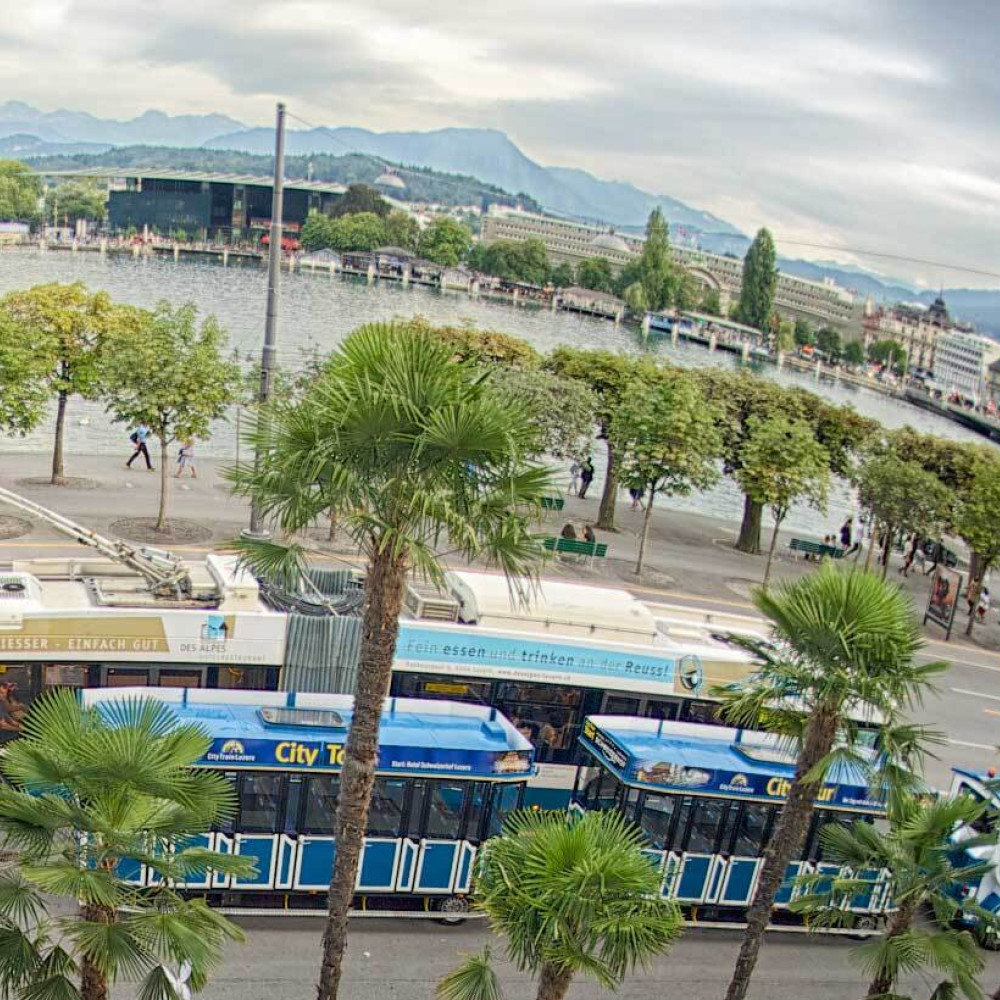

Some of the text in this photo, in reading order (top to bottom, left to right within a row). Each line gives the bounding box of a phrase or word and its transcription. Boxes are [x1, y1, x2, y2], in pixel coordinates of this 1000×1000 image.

[68, 638, 126, 650] EINFACH
[132, 639, 159, 651] GUT
[180, 643, 226, 653] DES ALPES
[407, 639, 438, 653] Fein
[442, 644, 486, 657] essen
[490, 648, 516, 661] und
[521, 650, 575, 666] trinken
[625, 661, 670, 677] Reuss!
[275, 742, 346, 766] City To
[767, 777, 791, 796] Cit
[818, 787, 836, 801] ur
